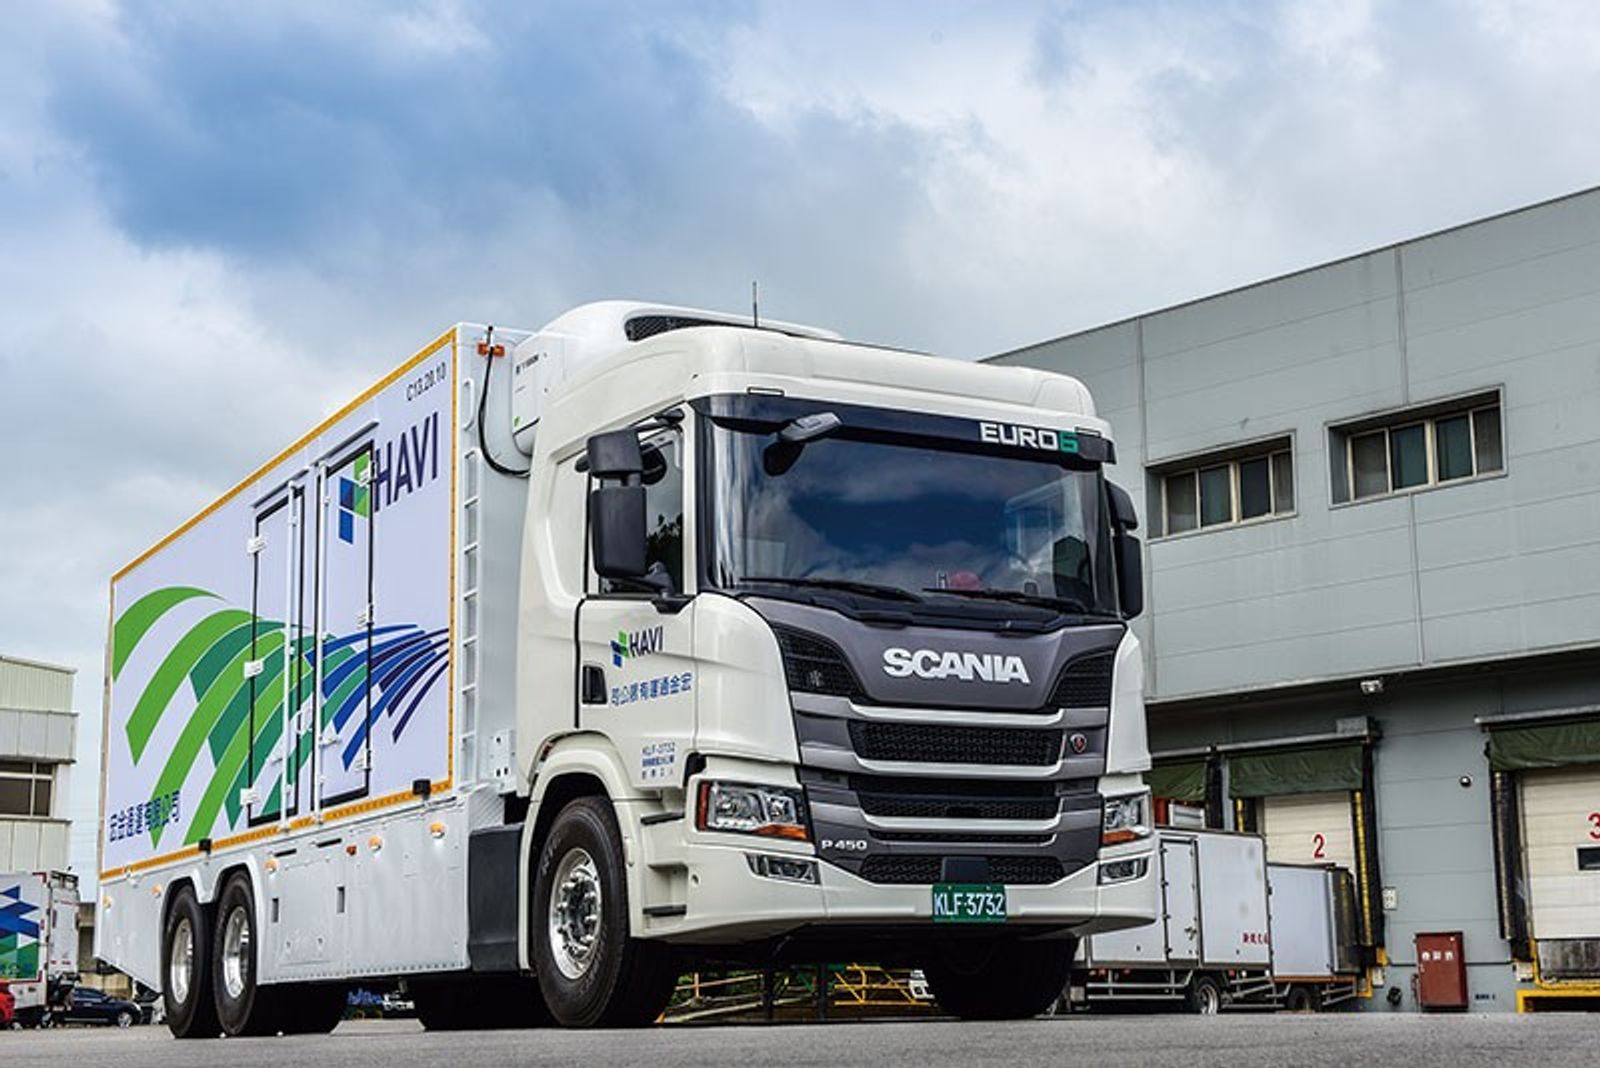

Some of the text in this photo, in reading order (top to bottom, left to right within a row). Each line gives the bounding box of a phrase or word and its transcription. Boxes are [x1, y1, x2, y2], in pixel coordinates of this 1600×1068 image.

[979, 421, 1079, 453] EURO6
[374, 411, 439, 513] HAVI
[629, 625, 664, 658] HAVI
[883, 648, 1031, 684] SCANIA
[1588, 812, 1600, 840] 3
[821, 840, 868, 851] P 450
[1313, 833, 1325, 859] 2
